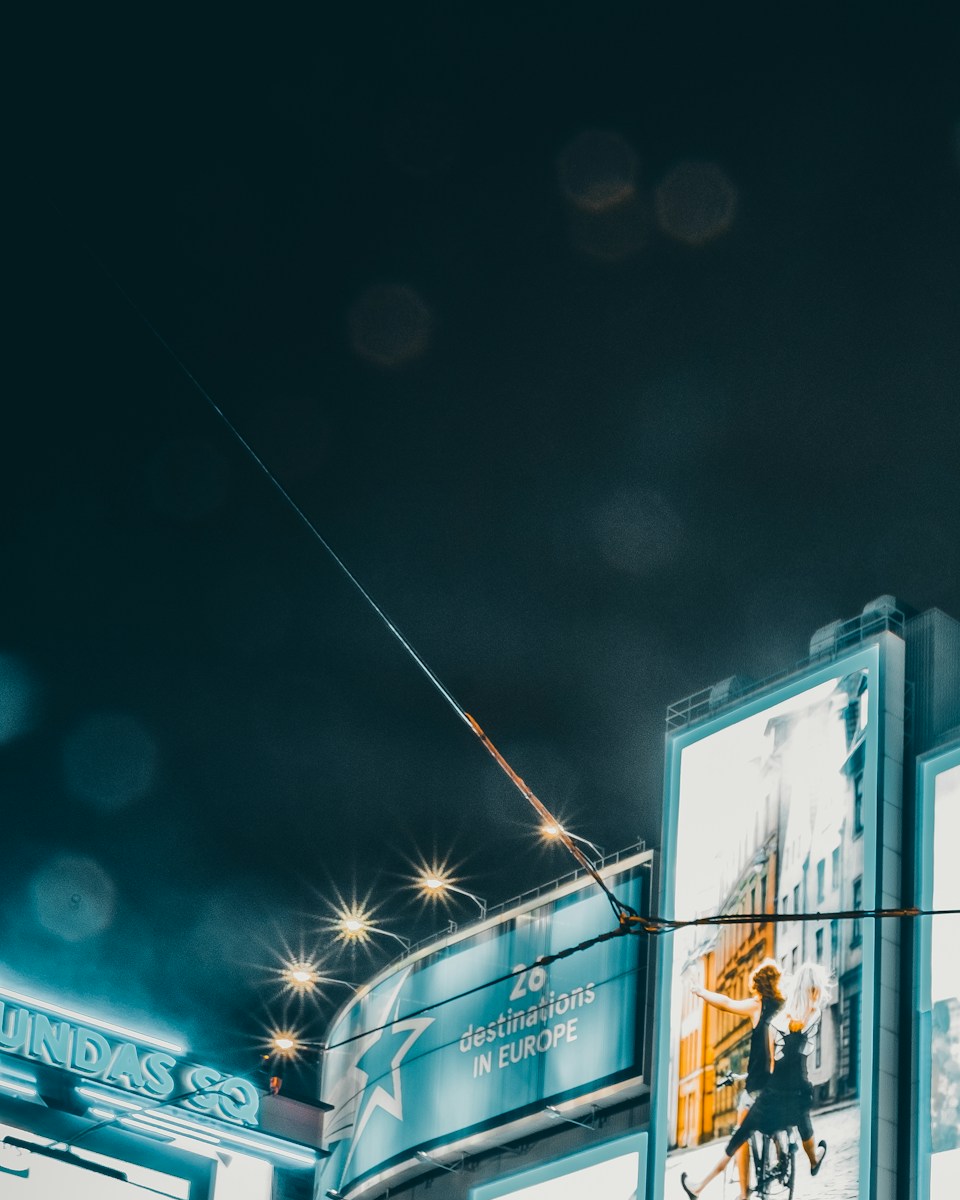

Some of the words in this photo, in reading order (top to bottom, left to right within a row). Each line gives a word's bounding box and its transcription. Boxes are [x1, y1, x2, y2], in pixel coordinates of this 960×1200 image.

[509, 957, 547, 1001] 26
[459, 982, 595, 1053] destinations
[472, 1053, 492, 1079] IN
[498, 1017, 578, 1070] EUROPE
[190, 1067, 259, 1126] SQ
